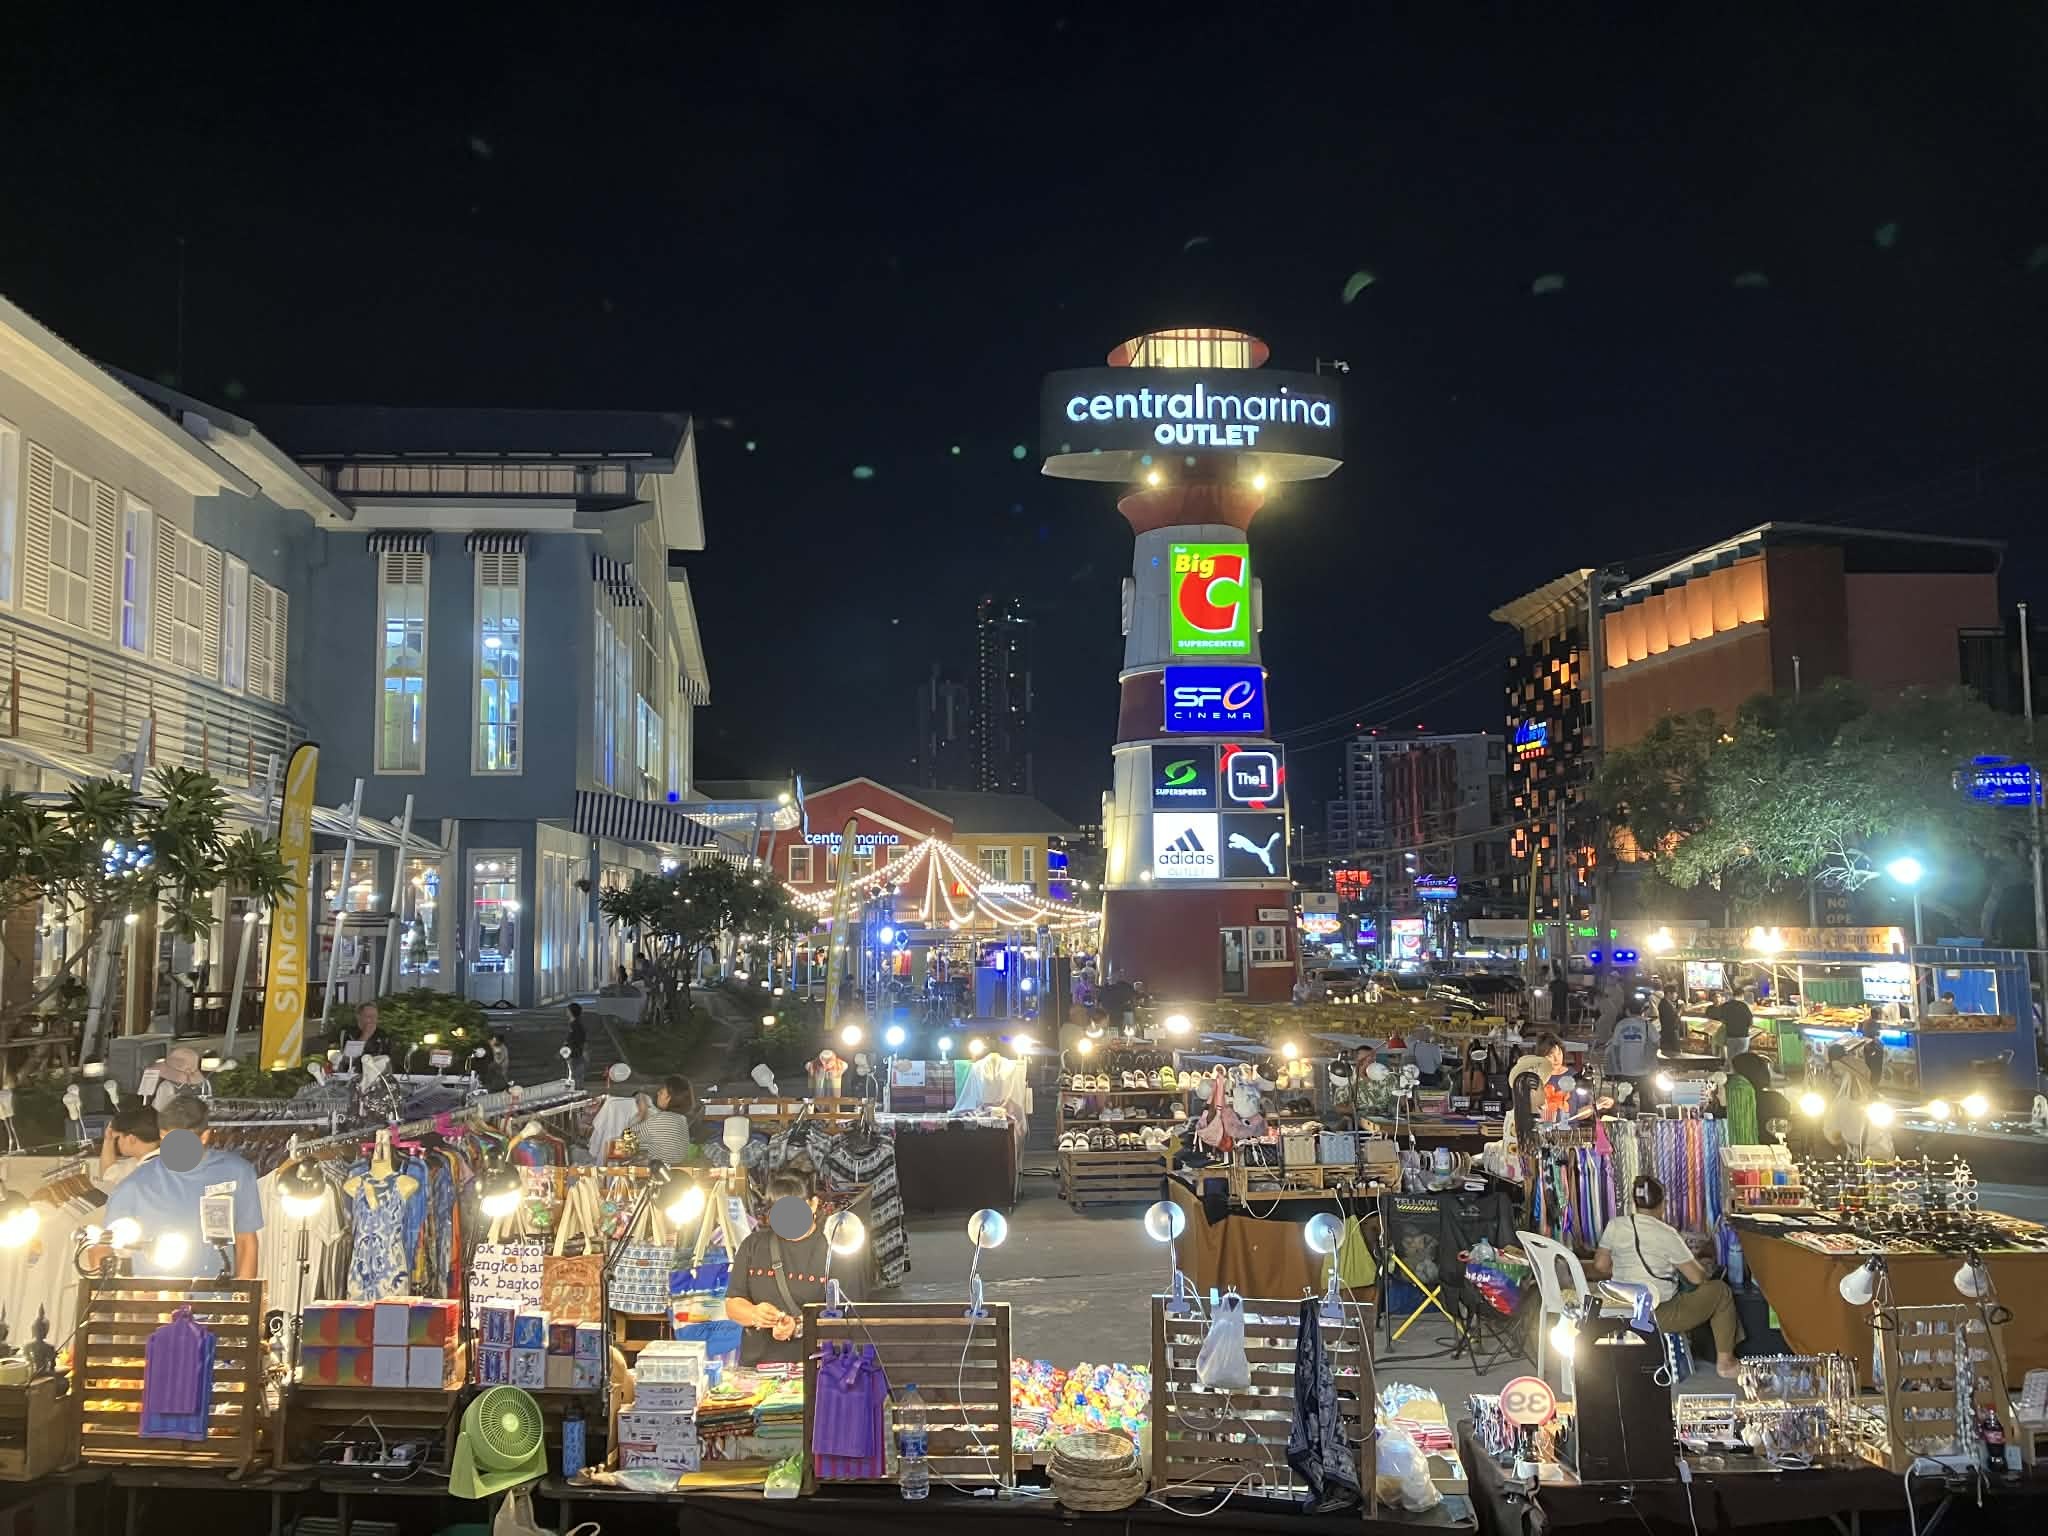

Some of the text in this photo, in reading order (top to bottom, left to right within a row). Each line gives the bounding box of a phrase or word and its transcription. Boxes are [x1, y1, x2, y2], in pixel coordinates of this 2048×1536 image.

[1066, 383, 1331, 427] centralmarina
[1154, 424, 1259, 446] OUTLET
[1175, 553, 1246, 633] Big C
[1177, 640, 1245, 648] SUPERCENTER
[1173, 711, 1251, 719] CINEMA
[1155, 788, 1208, 796] SUPERSPORTS
[1159, 852, 1215, 864] adidas
